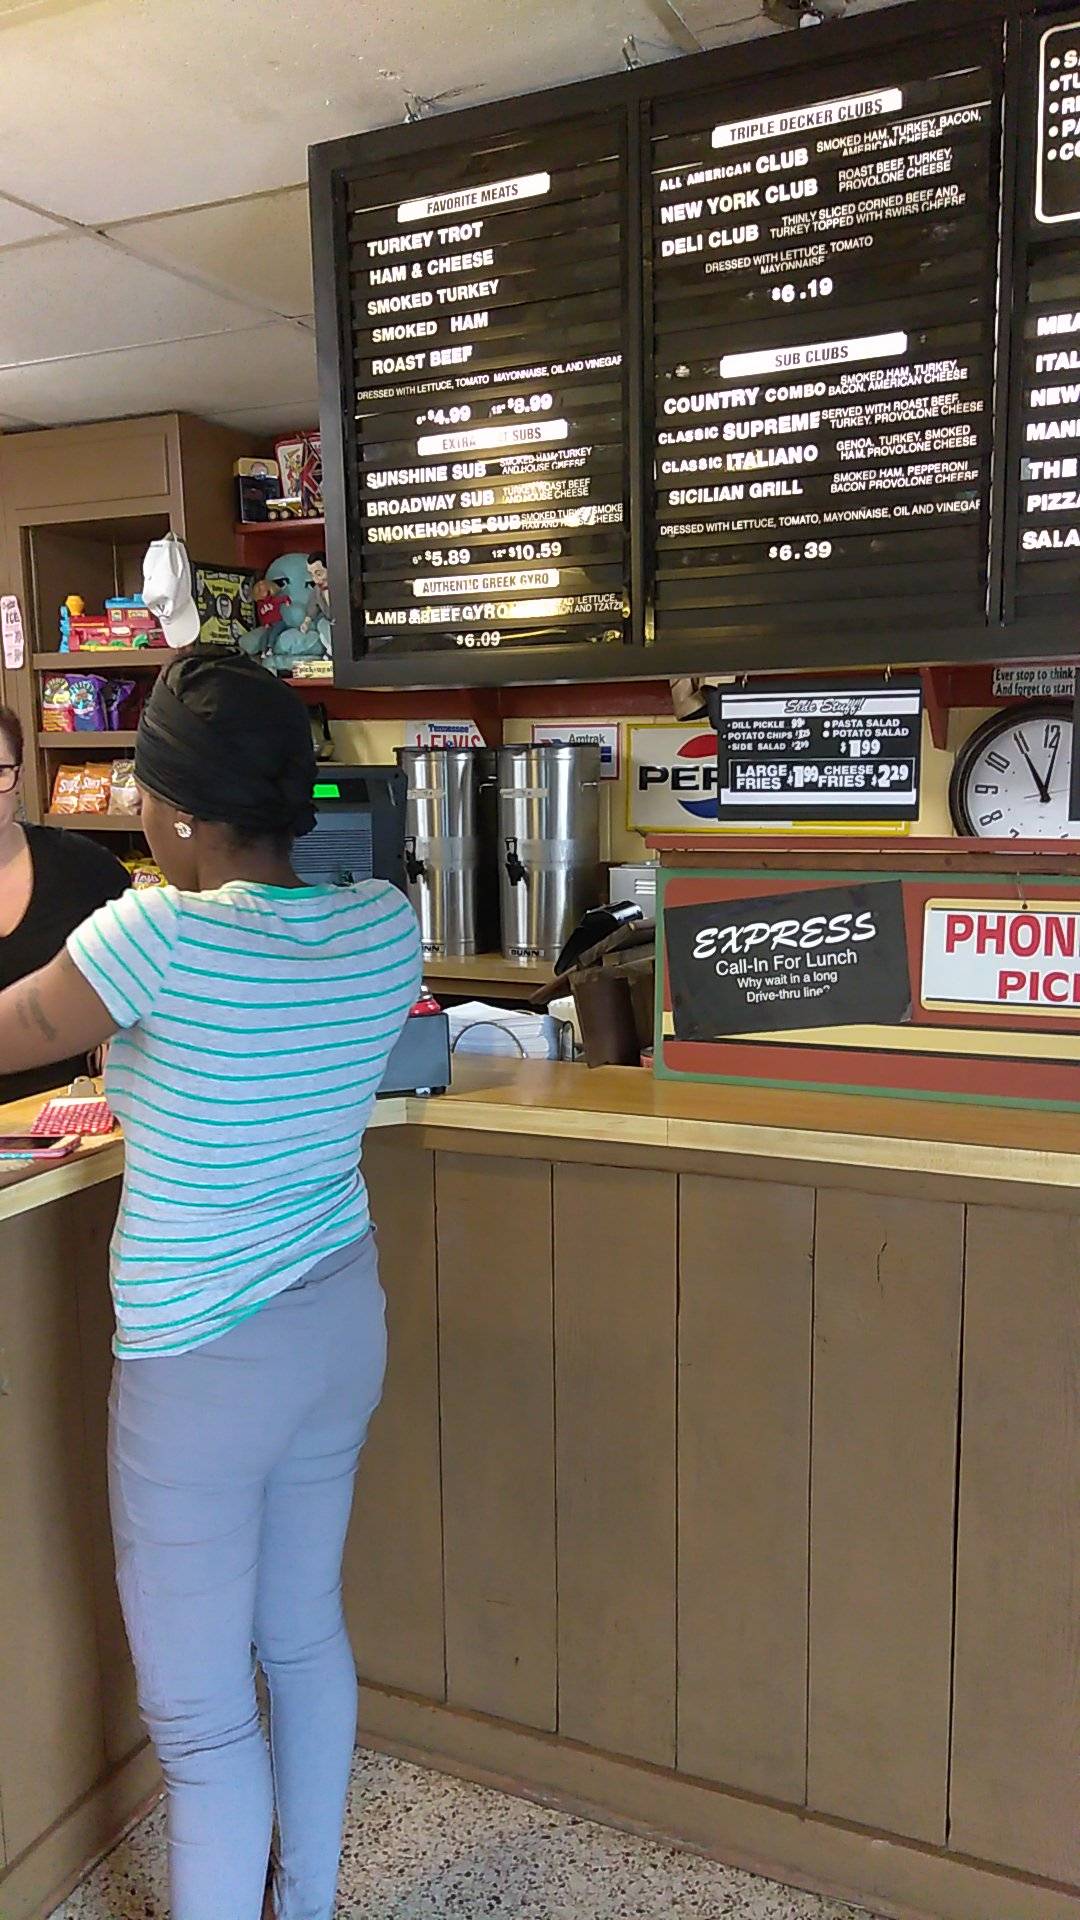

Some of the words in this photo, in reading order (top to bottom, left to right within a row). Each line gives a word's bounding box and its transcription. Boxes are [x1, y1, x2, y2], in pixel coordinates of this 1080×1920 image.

[730, 120, 774, 142] TRIPLE
[780, 109, 833, 132] DECKER
[838, 98, 882, 120] CLUBS
[660, 177, 682, 191] ALL
[687, 162, 751, 186] AMERICAN
[756, 148, 808, 174] CLUB
[838, 164, 874, 181] ROAST
[839, 171, 904, 193] PROVOLONE
[907, 160, 951, 178] CHEESE
[427, 193, 477, 214] FAVORITE
[481, 183, 519, 202] MEATS
[661, 200, 702, 224] NEW
[707, 189, 761, 215] YORK
[765, 178, 818, 203] CLUB
[782, 212, 816, 227] THINLY
[819, 203, 856, 220] SLICED
[858, 194, 903, 212] CORNED
[906, 188, 933, 204] BEEF
[935, 185, 959, 198] AND
[770, 223, 811, 239] TURKEY
[813, 215, 853, 232] TOPPED
[856, 210, 883, 224] WITH
[885, 204, 919, 218] SWISS
[367, 231, 433, 257] TURKEY
[438, 222, 483, 244] TROT
[662, 234, 703, 257] DELI
[709, 224, 759, 248] CLUB
[370, 265, 406, 286] HAM
[411, 262, 422, 279] &
[427, 249, 494, 275] CHEESE
[367, 292, 432, 316] SMOKED
[437, 279, 499, 304] TURKEY
[772, 277, 833, 302] $6.19
[372, 321, 437, 343] SMOKED
[450, 312, 489, 333] HAM
[372, 353, 425, 376] ROAST
[430, 345, 473, 368] BEEF
[775, 353, 800, 367] SUB
[806, 346, 849, 363] CLUBS
[840, 370, 883, 384] SMOKED
[868, 375, 921, 391] AMERICAN
[924, 368, 968, 383] CHEESE
[663, 387, 760, 414] COUNTRY
[765, 382, 826, 402] COMBO
[822, 406, 862, 420] SERVED
[865, 402, 891, 415] WITH
[893, 397, 929, 412] ROAST
[874, 406, 939, 424] PROVOLONE
[941, 400, 983, 415] CHEESE
[513, 427, 541, 441] SUBS
[658, 426, 718, 445] CLASSIC
[723, 411, 820, 440] SUPREME
[924, 425, 971, 440] SMOKED
[867, 441, 931, 457] PROVOLONE
[933, 435, 978, 450] CHEESE
[662, 457, 722, 473] CLASSIC
[726, 445, 818, 471] ITALIANO
[1029, 458, 1078, 480] THE
[366, 466, 447, 489] SUNSHINE
[452, 463, 486, 480] SUB
[366, 494, 456, 517] BROADWAY
[460, 490, 494, 508] SUB
[669, 485, 744, 505] SICILIAN
[750, 480, 803, 498] GRILL
[367, 521, 481, 543] SMOKEHOUSE
[487, 515, 521, 531] SUB
[661, 524, 704, 536] DRESSED
[706, 522, 730, 533] WITH
[893, 505, 910, 517] OIL
[912, 503, 934, 515] AND
[425, 549, 470, 566] $5.89
[508, 542, 562, 560] $10.59
[769, 541, 832, 561] $6.39
[422, 576, 479, 594] AUTHENTIC
[483, 574, 516, 589] GREEK
[365, 609, 406, 625] LAMB
[463, 603, 507, 621] GYRO
[456, 631, 500, 647] $6.09
[996, 669, 1013, 681] Ever
[1016, 670, 1035, 681] stop
[1037, 669, 1048, 680] to
[995, 683, 1013, 695] And
[1014, 683, 1040, 696] forget
[1041, 683, 1051, 694] to
[1052, 682, 1073, 694] start
[784, 698, 817, 714] Side
[732, 721, 751, 729] DILL
[753, 720, 784, 729] PICKLE
[832, 719, 863, 728] PASTA
[866, 719, 900, 728] SALAD
[832, 729, 872, 738] POTATO
[874, 728, 909, 736] SALAD
[569, 733, 605, 744] Amtrak
[728, 731, 764, 740] POTATO
[766, 731, 793, 739] CHIPS
[732, 743, 753, 751] SIDE
[757, 743, 786, 751] SALAD
[736, 765, 788, 778] LARGE
[824, 765, 873, 775] CHEESE
[736, 778, 781, 790] FRIES
[818, 775, 865, 788] FRIES
[693, 912, 876, 959] EXPRESS
[716, 957, 768, 976] Call-In
[773, 955, 801, 971] For
[806, 949, 858, 968] Lunch
[737, 975, 763, 990] Why
[765, 973, 787, 986] wait
[790, 972, 800, 984] in
[803, 974, 811, 983] a
[813, 970, 838, 985] long
[746, 985, 801, 1004] Drive-thru
